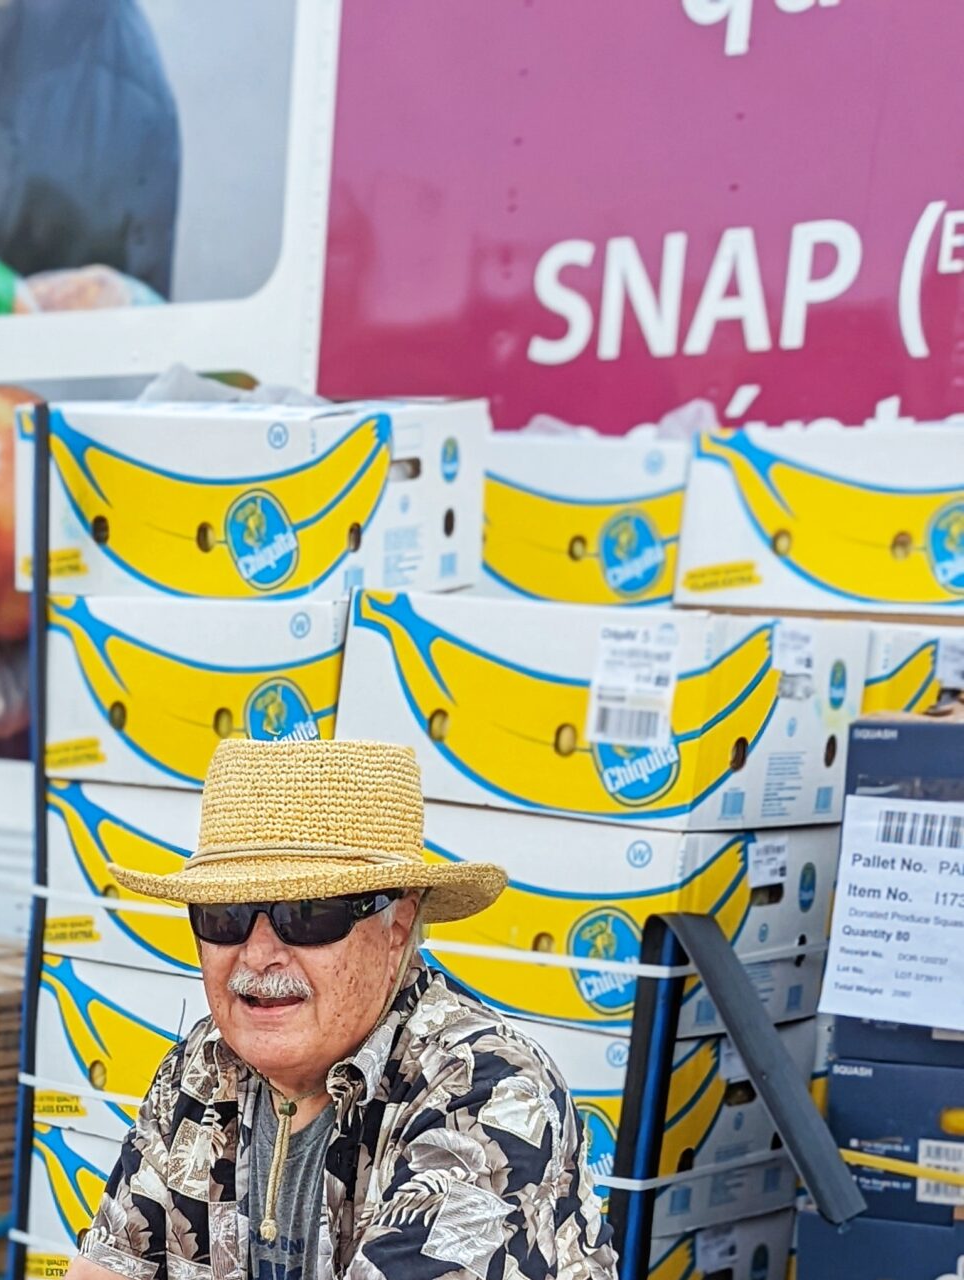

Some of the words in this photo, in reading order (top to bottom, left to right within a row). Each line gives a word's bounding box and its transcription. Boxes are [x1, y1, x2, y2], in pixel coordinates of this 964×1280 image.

[527, 219, 863, 366] SNAP
[602, 738, 679, 794] Chiquita
[851, 853, 895, 870] Pallet
[900, 857, 928, 873] No.
[847, 883, 881, 899] Item
[886, 886, 913, 902] No.
[891, 911, 931, 924] Produce
[842, 924, 893, 942] Quantity
[895, 930, 911, 942] 80
[832, 1064, 874, 1078] SQUASH
